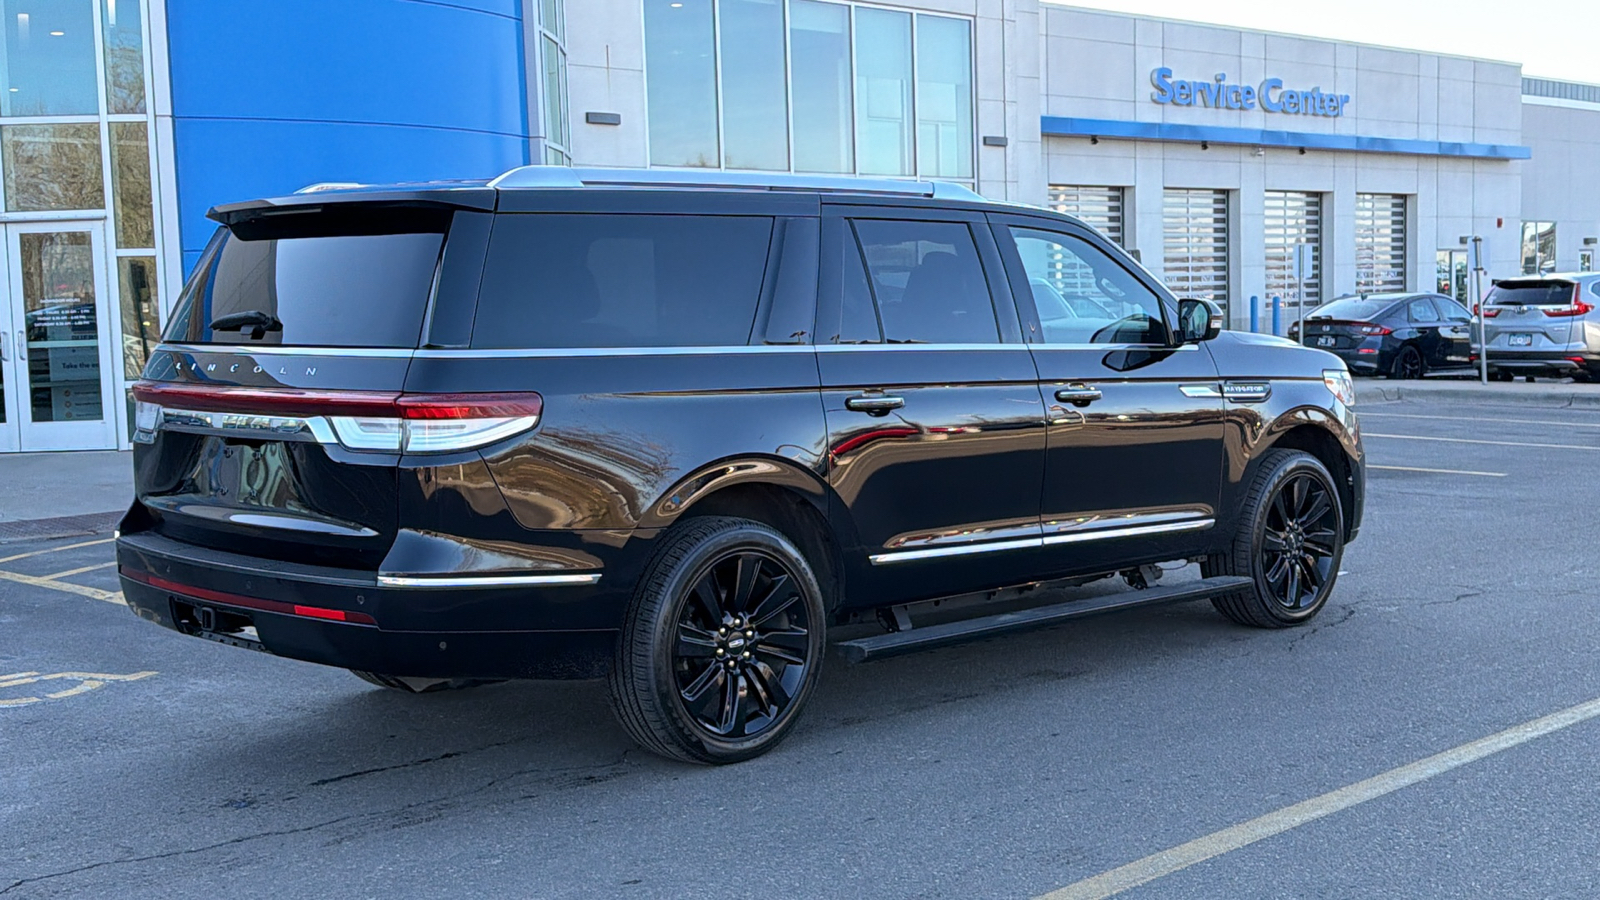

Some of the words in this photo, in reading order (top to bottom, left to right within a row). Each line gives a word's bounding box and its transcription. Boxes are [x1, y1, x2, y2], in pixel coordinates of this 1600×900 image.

[1151, 67, 1255, 110] Service
[1258, 78, 1349, 117] Center
[175, 362, 317, 376] LINCOLN
